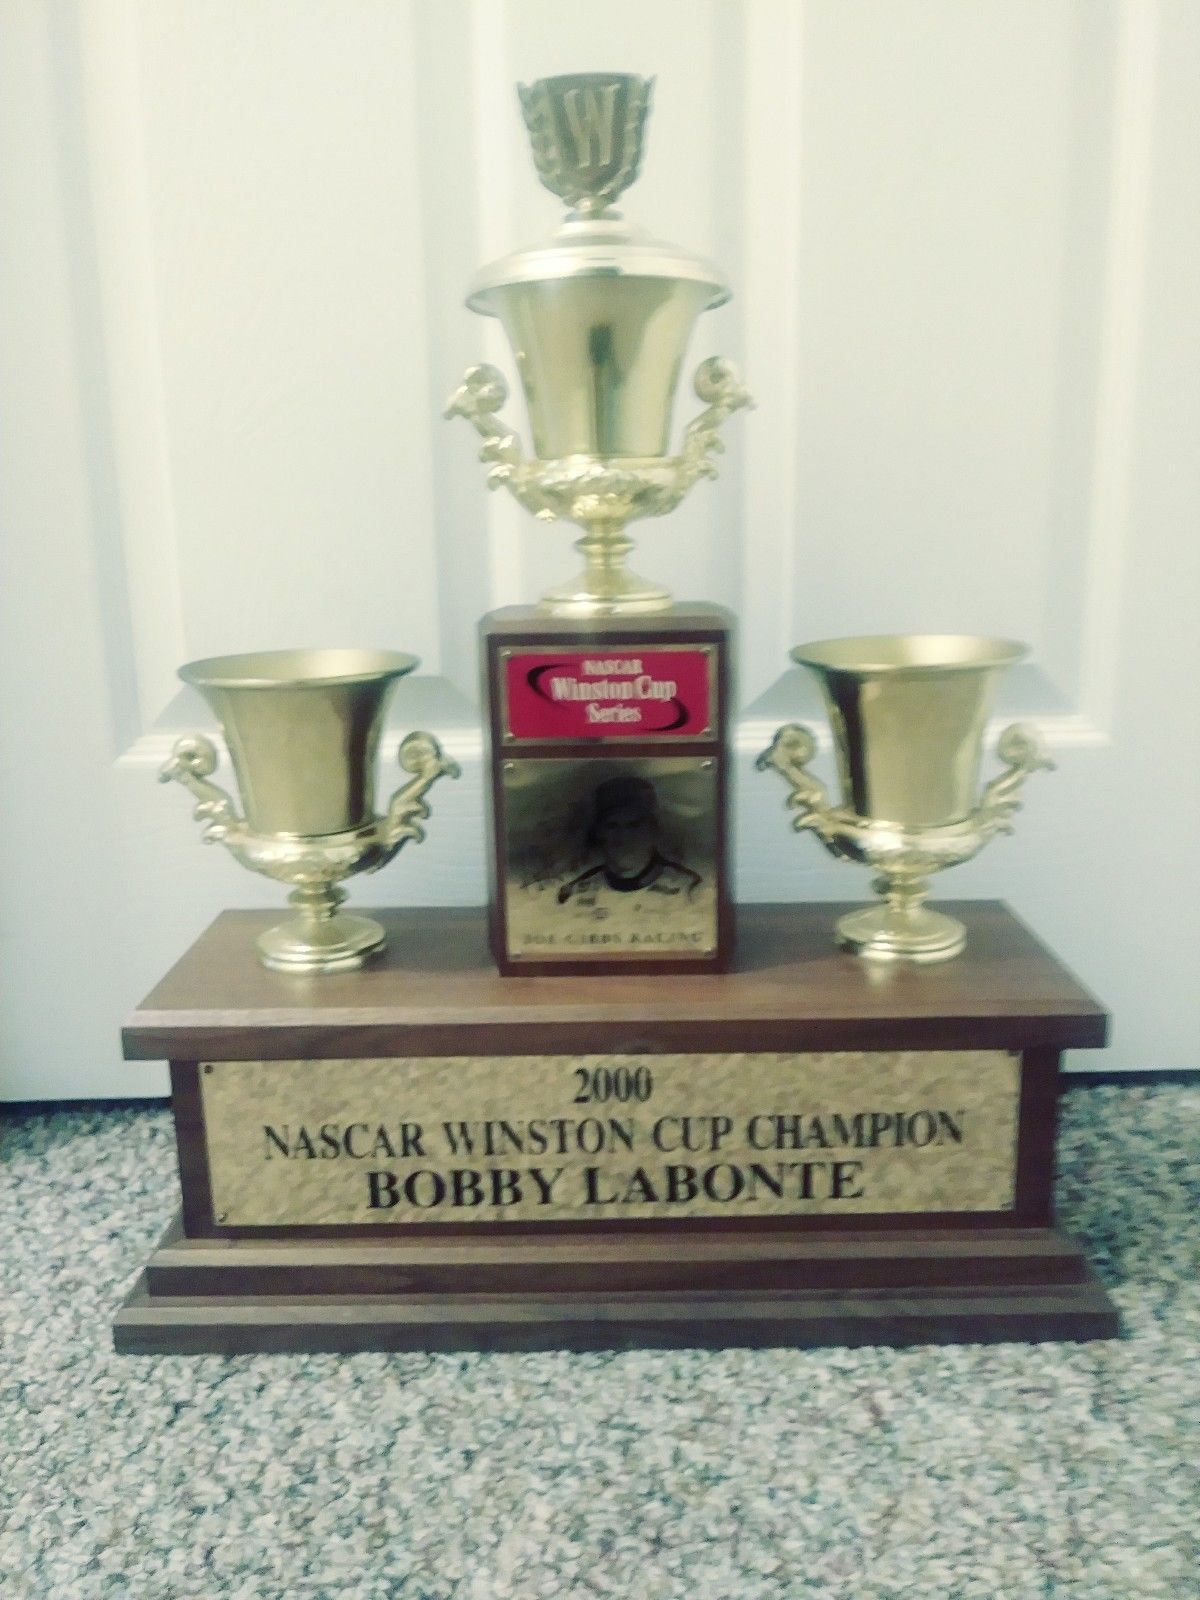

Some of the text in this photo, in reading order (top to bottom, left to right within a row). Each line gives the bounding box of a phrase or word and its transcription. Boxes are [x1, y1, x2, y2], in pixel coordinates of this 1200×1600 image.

[551, 676, 677, 702] Winston Cup
[586, 702, 642, 723] Series
[573, 1067, 652, 1104] 2000
[263, 1110, 964, 1161] NASCAR WINSTON CUP CHAMPION
[366, 1160, 866, 1210] BOBBY LABONTE
